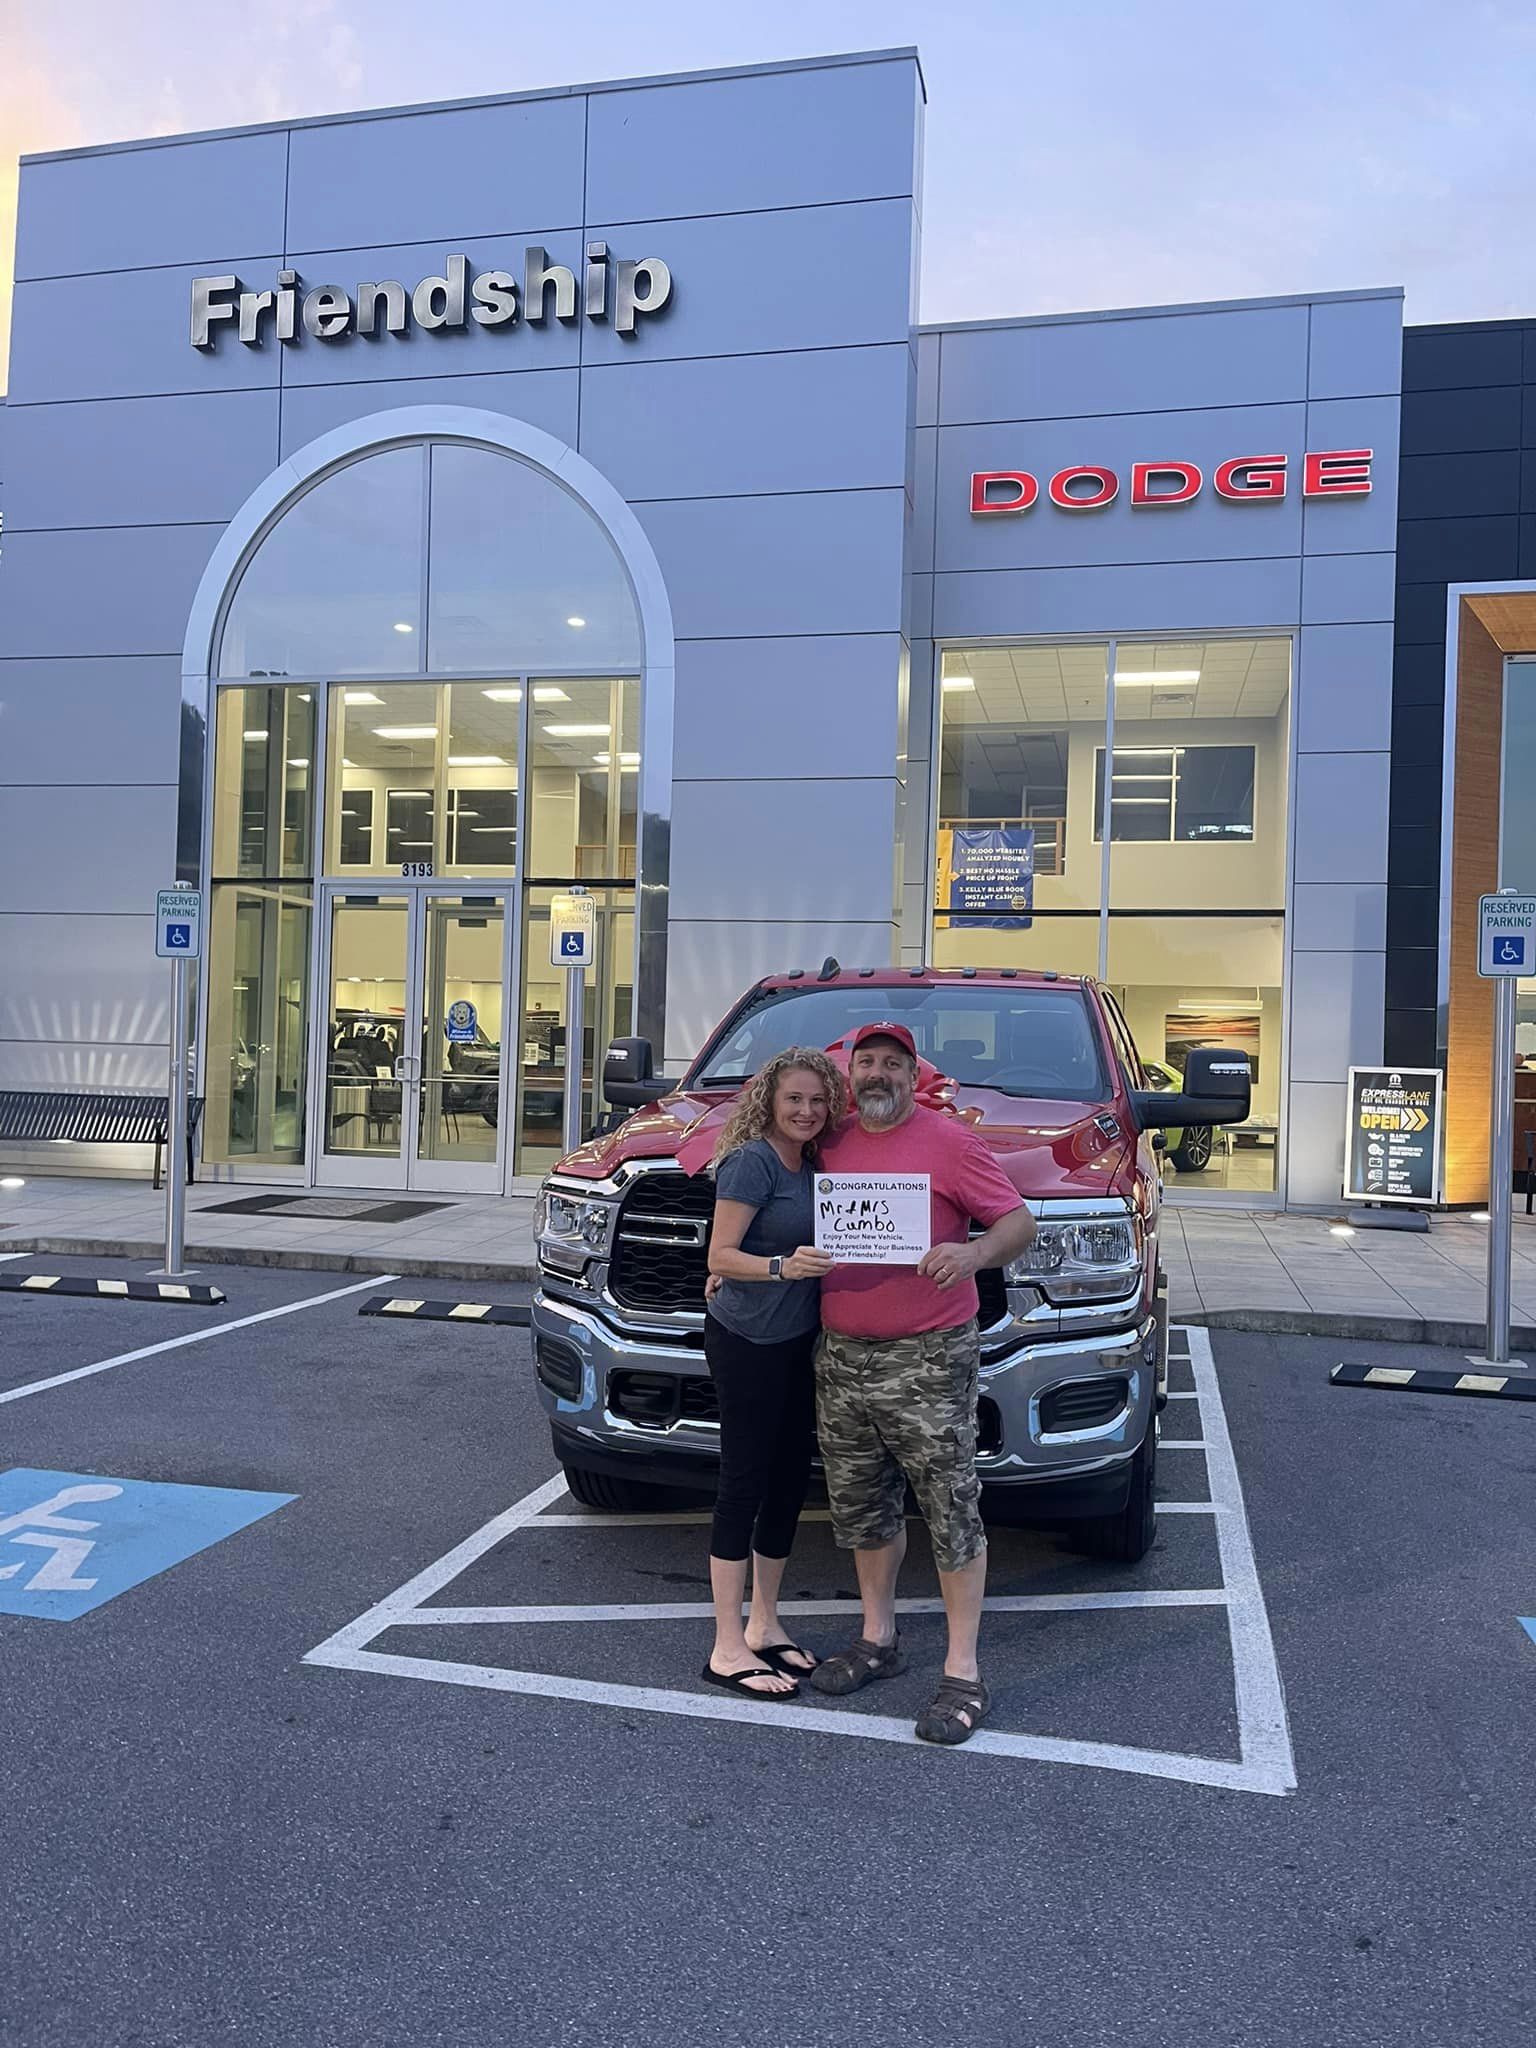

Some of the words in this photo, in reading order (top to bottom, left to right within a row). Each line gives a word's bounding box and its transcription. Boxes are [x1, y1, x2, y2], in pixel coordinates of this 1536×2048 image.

[190, 241, 675, 350] Friendship
[970, 448, 1374, 514] DODGE
[402, 863, 433, 877] 3193
[159, 895, 199, 906] RESERVED
[161, 907, 197, 918] PARKING
[1484, 902, 1536, 914] RESERVED
[1487, 916, 1532, 928] PARKING
[1360, 1114, 1400, 1130] OPEN
[834, 1182, 927, 1191] CONGRATULATIONS!
[820, 1200, 843, 1220] Mr
[834, 1215, 895, 1232] Cumbo
